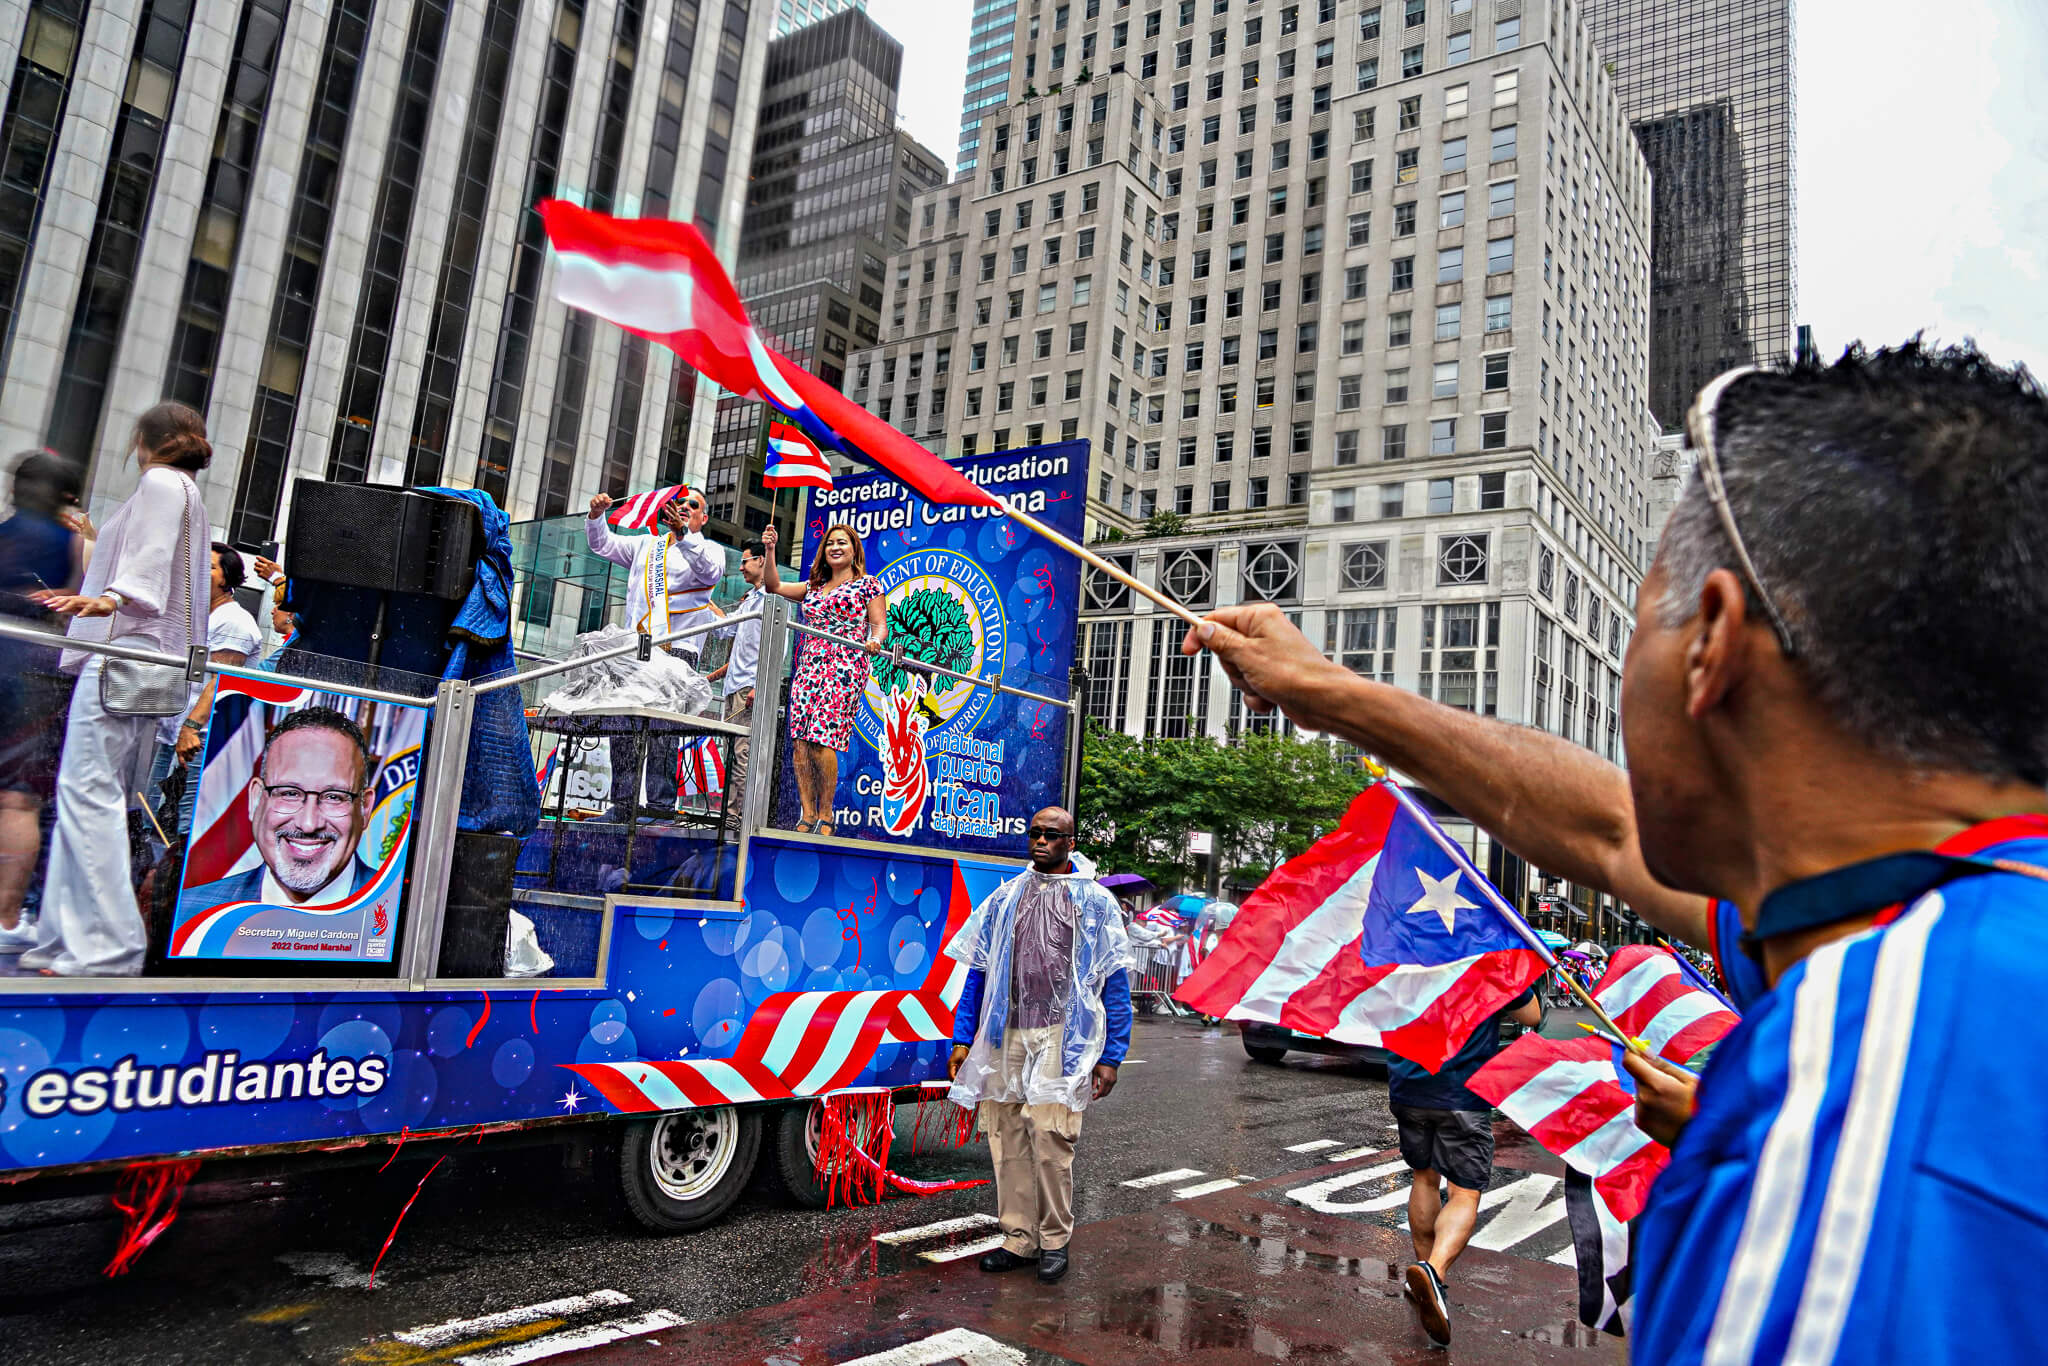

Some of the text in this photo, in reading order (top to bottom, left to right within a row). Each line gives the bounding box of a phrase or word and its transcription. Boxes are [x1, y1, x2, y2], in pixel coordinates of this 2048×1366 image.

[951, 454, 1069, 486] ducation
[827, 500, 914, 539] Miguel
[655, 563, 665, 597] MARSHAL
[925, 554, 949, 574] OF
[948, 558, 1002, 663] EDUCATION
[858, 702, 882, 740] NITED
[944, 692, 989, 738] MERICA
[939, 731, 1004, 763] national
[938, 755, 1001, 787] puerto
[934, 777, 1000, 823] rican
[934, 815, 956, 837] day
[238, 926, 359, 940] Secretary Miguel Cardona
[271, 941, 352, 952] 2022 Grand Marshal
[27, 1052, 386, 1115] estudiantes
